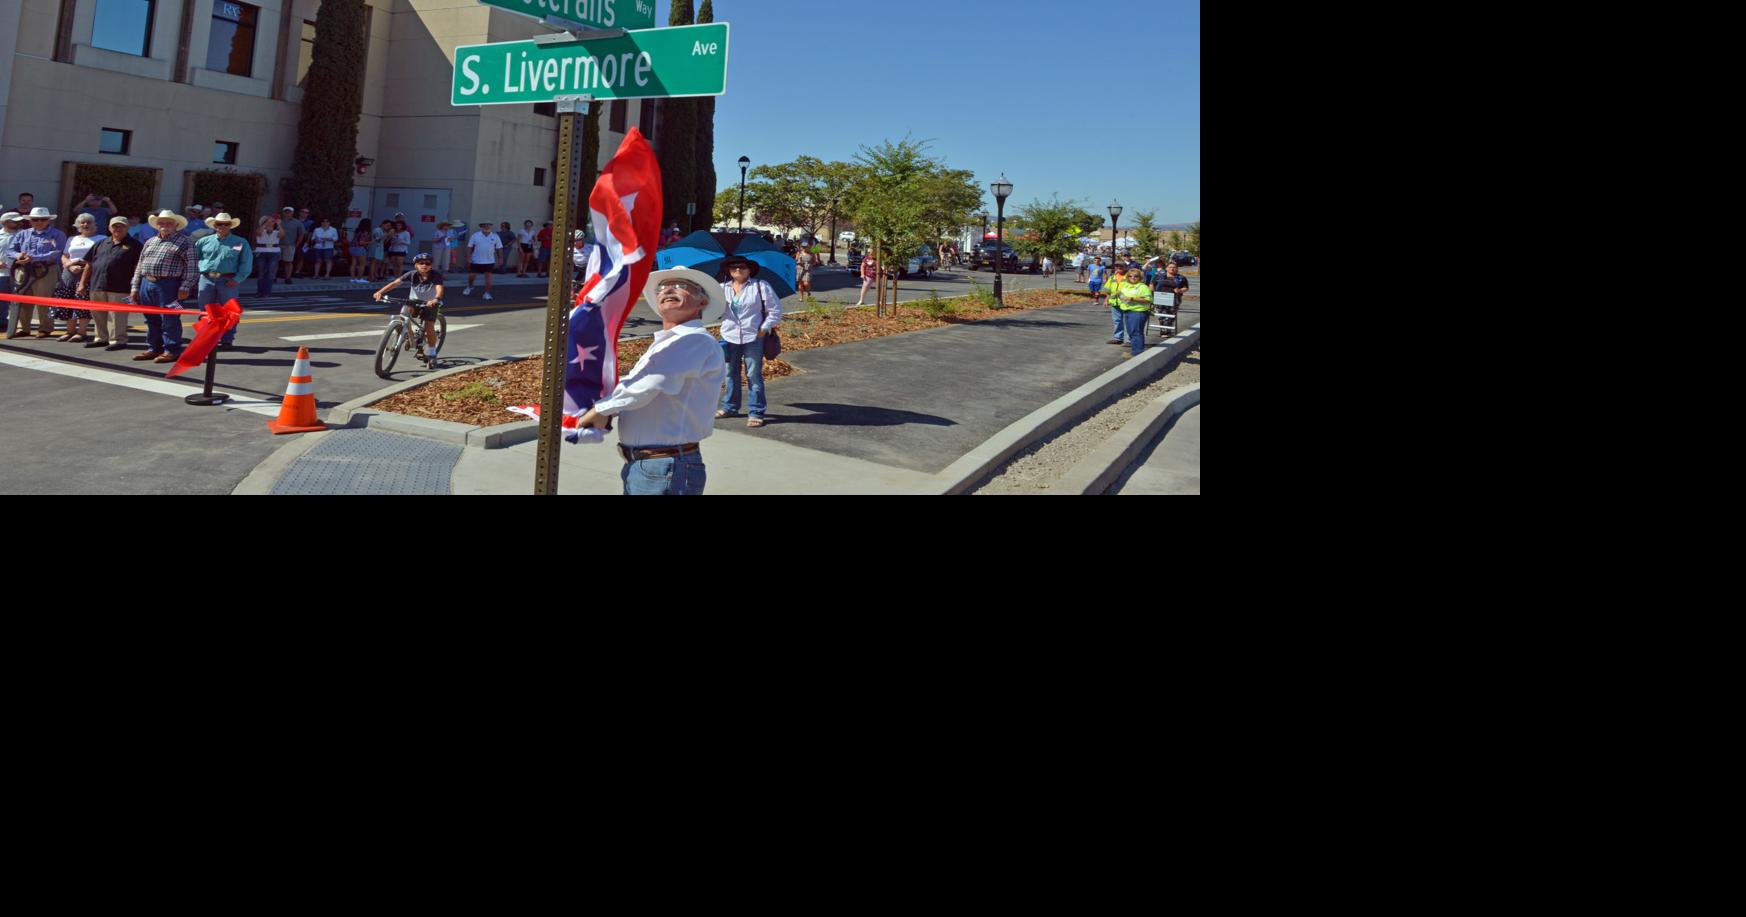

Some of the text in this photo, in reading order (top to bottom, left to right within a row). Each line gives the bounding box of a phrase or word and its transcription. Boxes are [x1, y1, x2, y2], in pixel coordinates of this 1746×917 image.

[635, 0, 652, 17] Way
[460, 40, 717, 95] S. Livermore Ave
